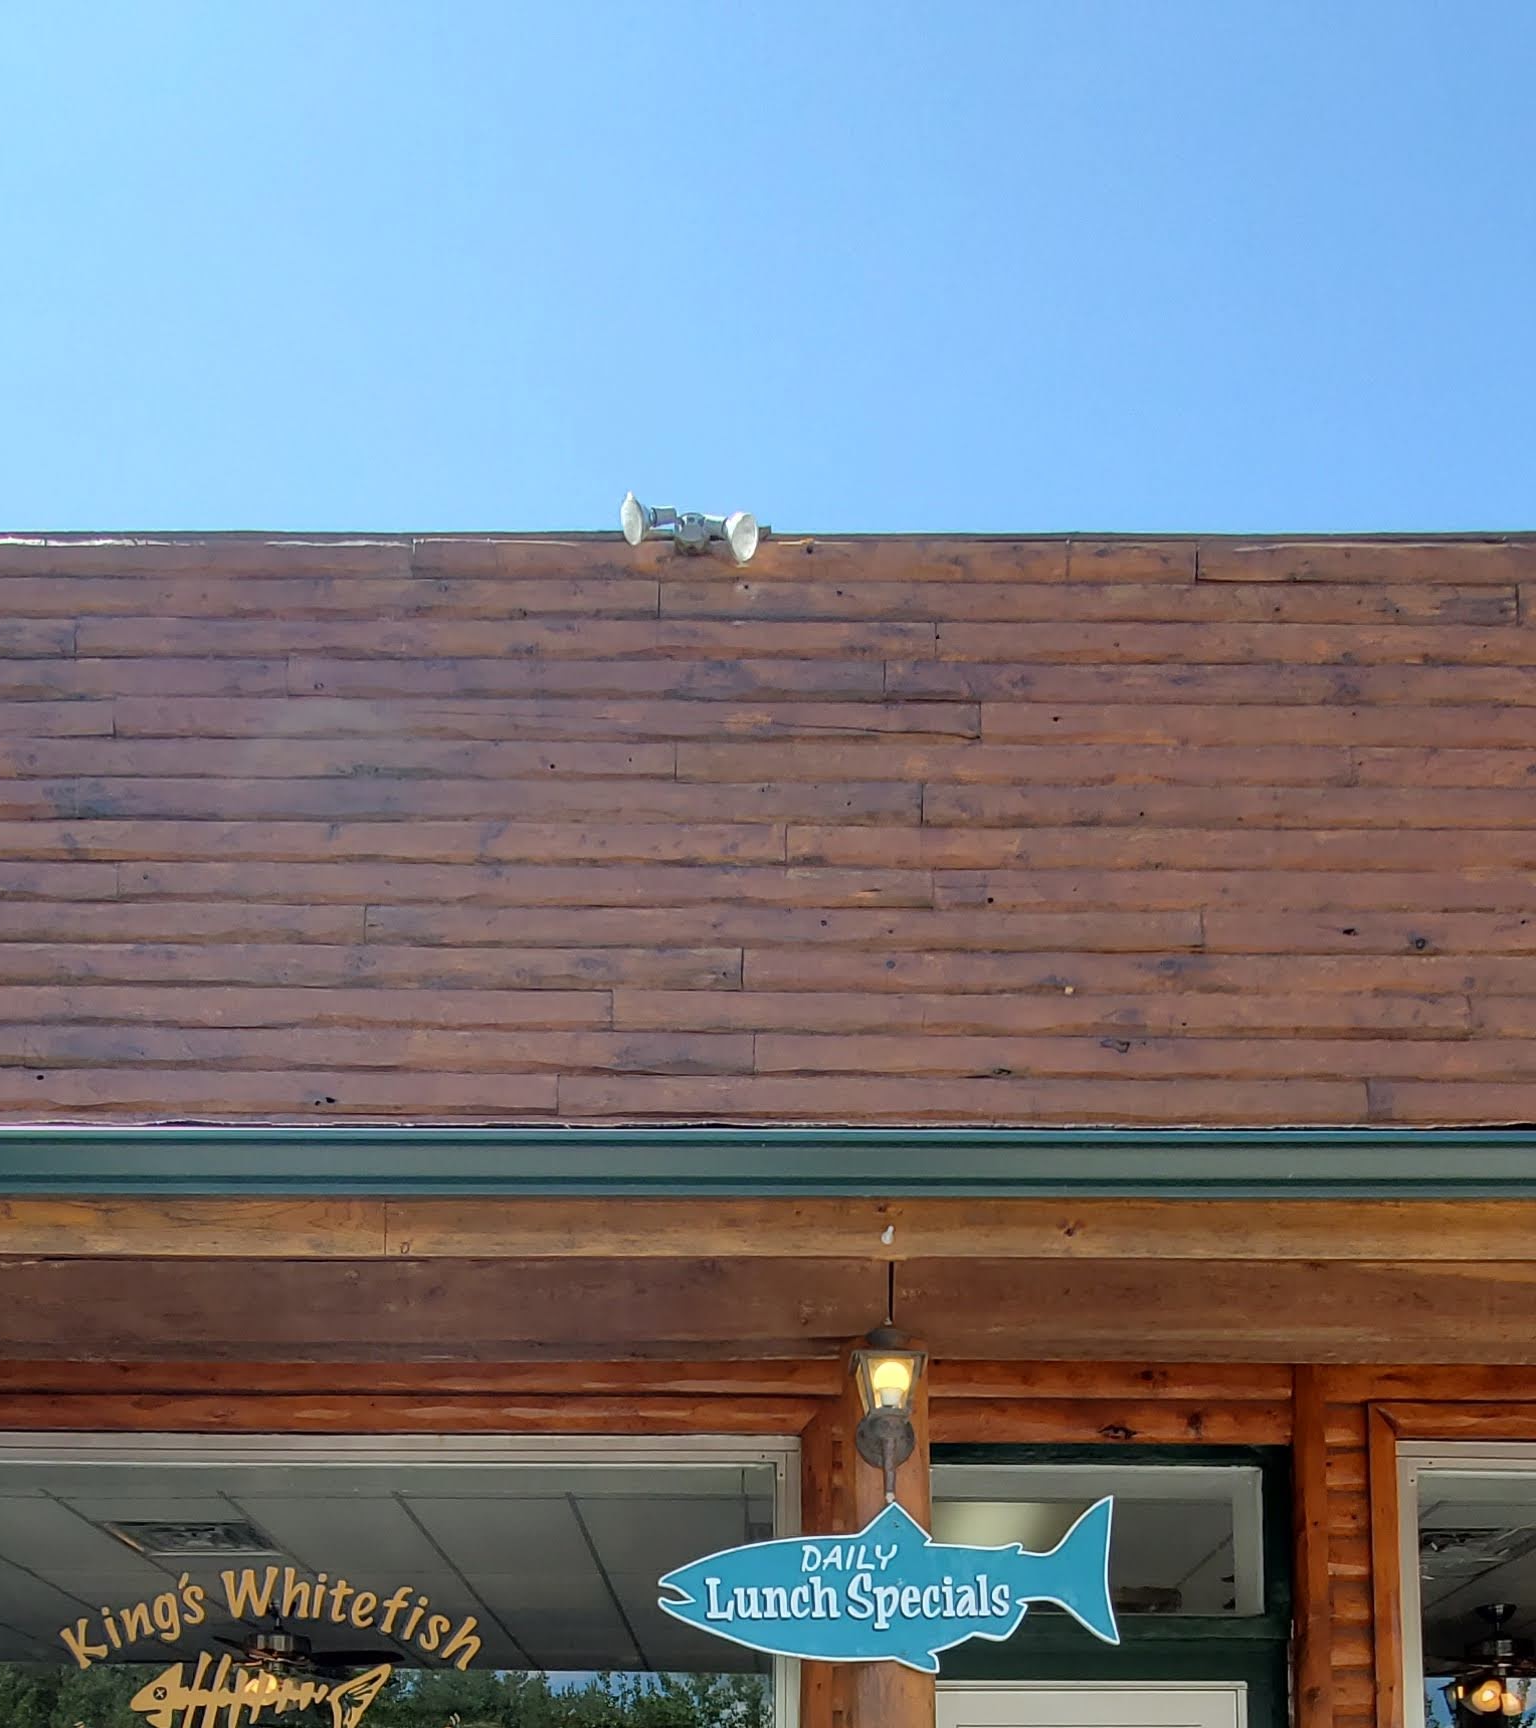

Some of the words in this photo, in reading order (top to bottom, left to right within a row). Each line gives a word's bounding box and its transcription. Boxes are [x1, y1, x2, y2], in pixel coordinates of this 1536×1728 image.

[801, 1544, 898, 1573] DAILY
[59, 1572, 205, 1669] King's
[221, 1566, 482, 1671] Whitefish
[704, 1575, 841, 1621] Lunch
[847, 1573, 1011, 1630] Specials
